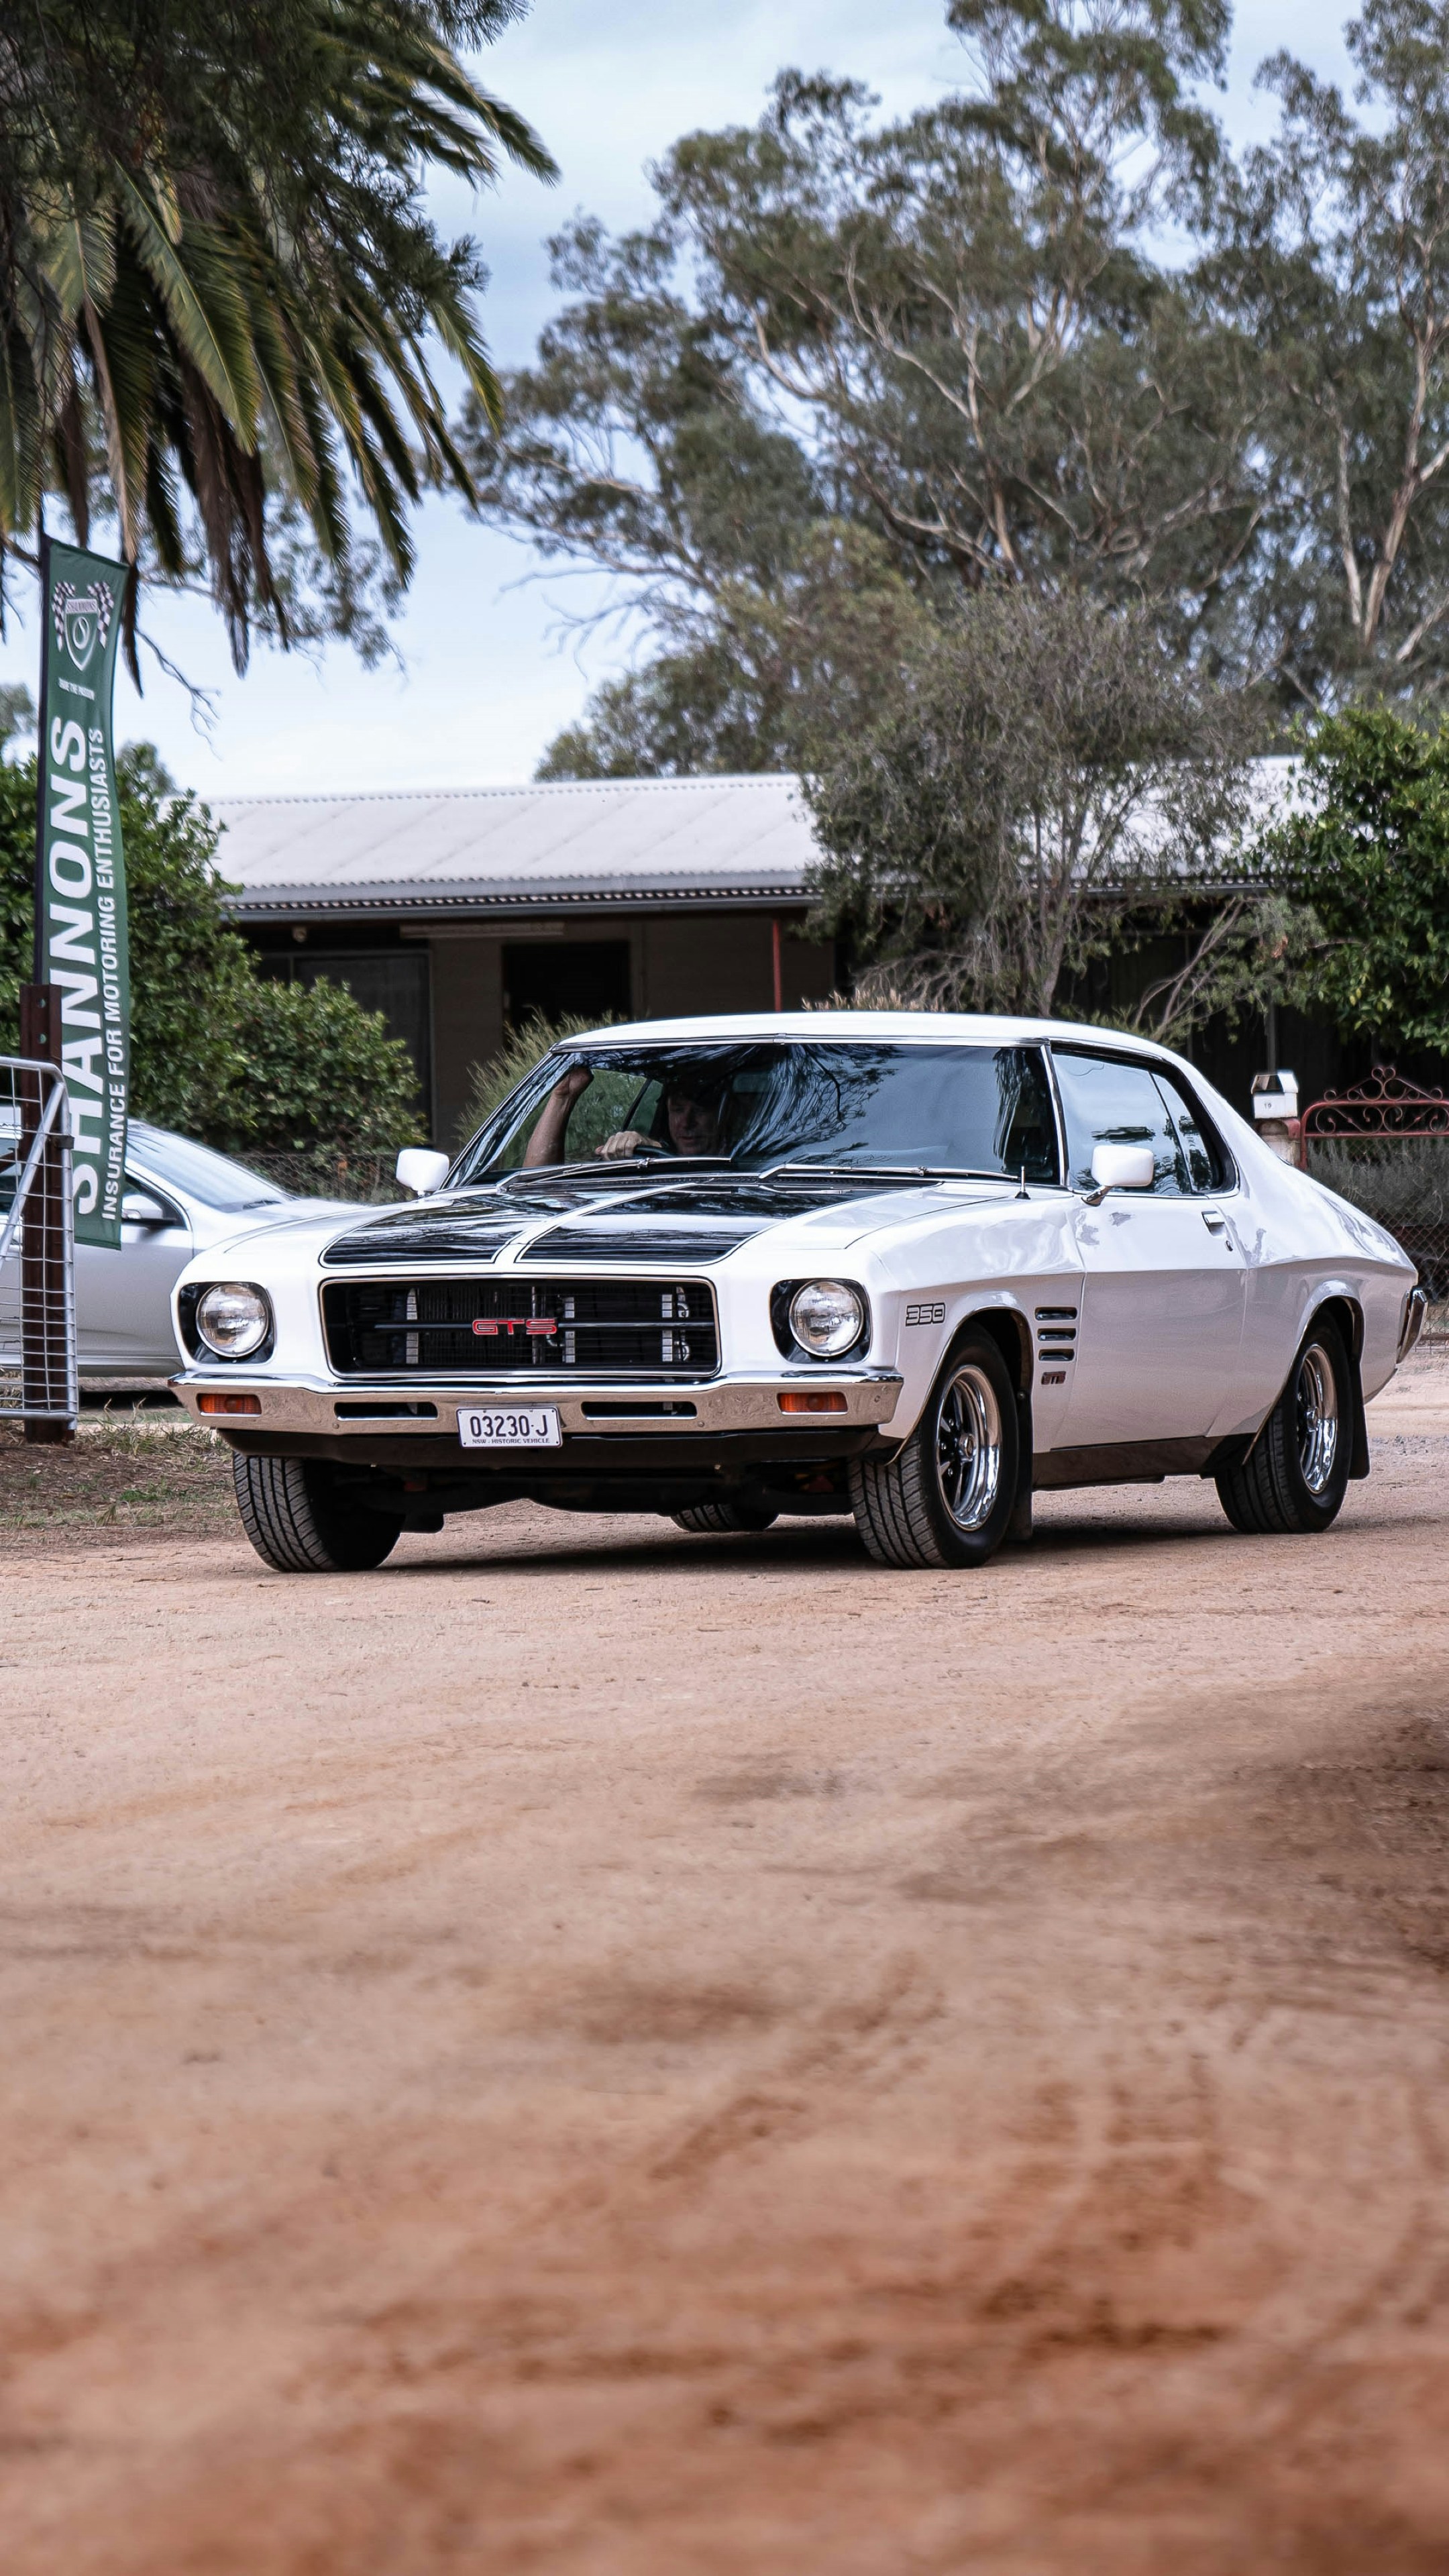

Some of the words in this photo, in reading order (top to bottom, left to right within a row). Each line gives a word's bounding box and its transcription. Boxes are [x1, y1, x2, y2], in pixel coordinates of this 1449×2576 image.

[88, 727, 114, 890] ENTHUSIASTS
[49, 716, 103, 1215] SHANNONS
[97, 896, 121, 1022] MOTORING
[105, 1030, 125, 1077] FOR
[101, 1082, 125, 1220] INSURANCE
[472, 1318, 557, 1335] GTS
[905, 1302, 946, 1327] 350
